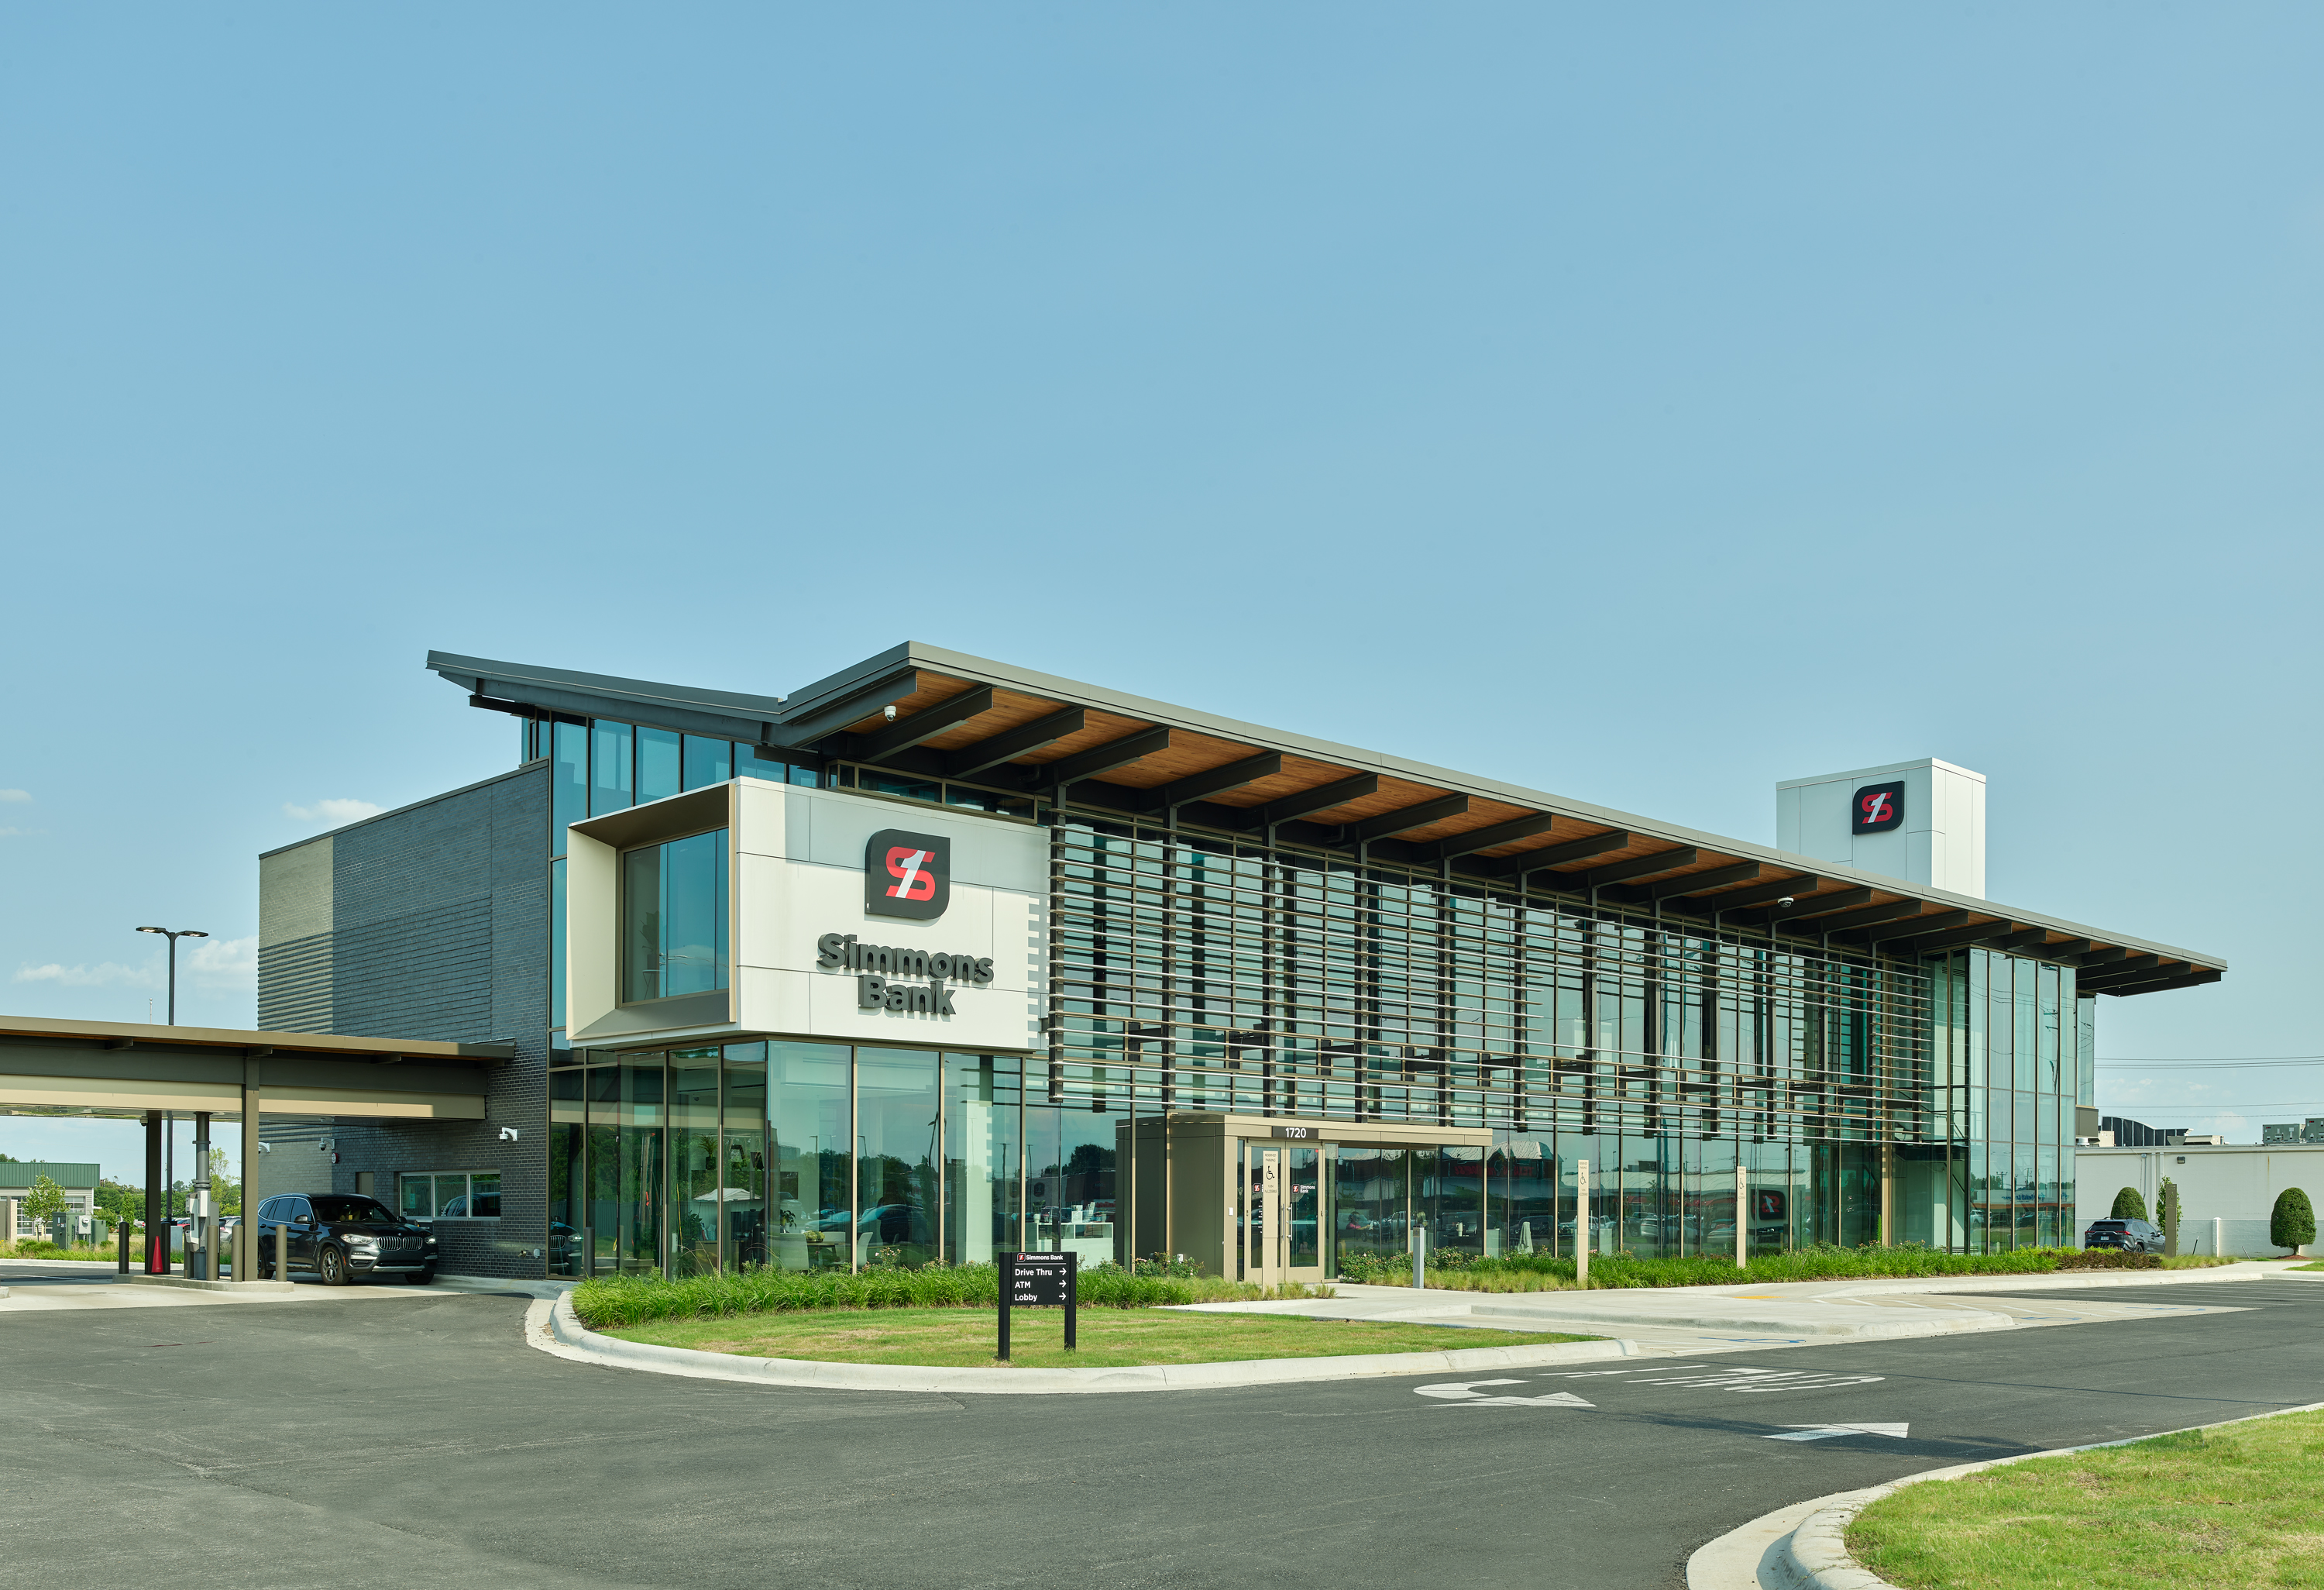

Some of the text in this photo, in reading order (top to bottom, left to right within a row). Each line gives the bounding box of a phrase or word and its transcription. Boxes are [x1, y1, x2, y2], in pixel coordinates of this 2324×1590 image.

[816, 933, 994, 983] Simmons
[858, 974, 956, 1015] Bank
[1285, 1127, 1307, 1138] 1720
[1015, 1268, 1053, 1276] Drive Thru
[1014, 1293, 1038, 1302] Lobby
